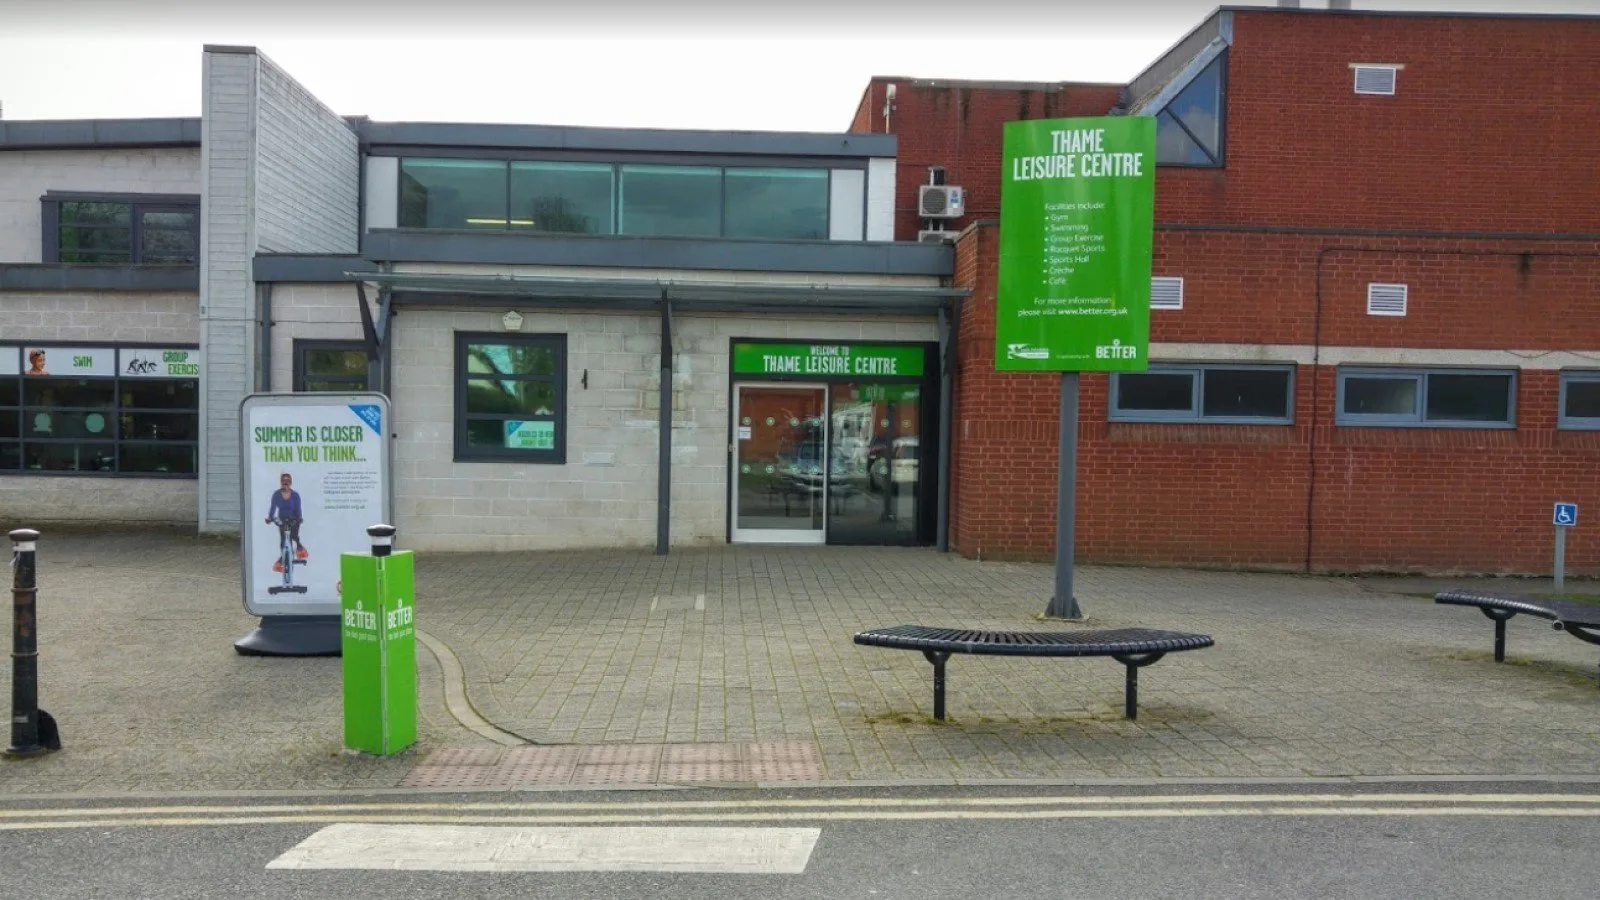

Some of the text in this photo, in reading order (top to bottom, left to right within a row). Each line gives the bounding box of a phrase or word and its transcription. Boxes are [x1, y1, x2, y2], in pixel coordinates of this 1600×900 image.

[1051, 129, 1104, 154] THAME
[1013, 152, 1143, 181] LEISURE CENTRE
[1050, 213, 1069, 223] Gym
[1050, 224, 1089, 233] Swimming
[1050, 234, 1105, 244] Group Exercise
[1050, 244, 1106, 255] Racquet Sports
[1050, 254, 1090, 265] Sports Hall
[1034, 297, 1047, 305] For
[1068, 296, 1113, 304] information
[1018, 307, 1128, 317] please visit www.better.org.uk
[811, 345, 850, 356] WELCOME TO
[1095, 345, 1137, 359] BETTER
[73, 356, 93, 367] SWIM
[162, 351, 189, 362] GROUP
[763, 355, 897, 375] THAME LEISURE CENTRE
[254, 425, 363, 443] SUMMER IS CLOSER
[264, 445, 293, 462] THAN
[296, 445, 318, 462] YOU
[344, 607, 377, 630] BETTER
[387, 605, 413, 629] BETTER
